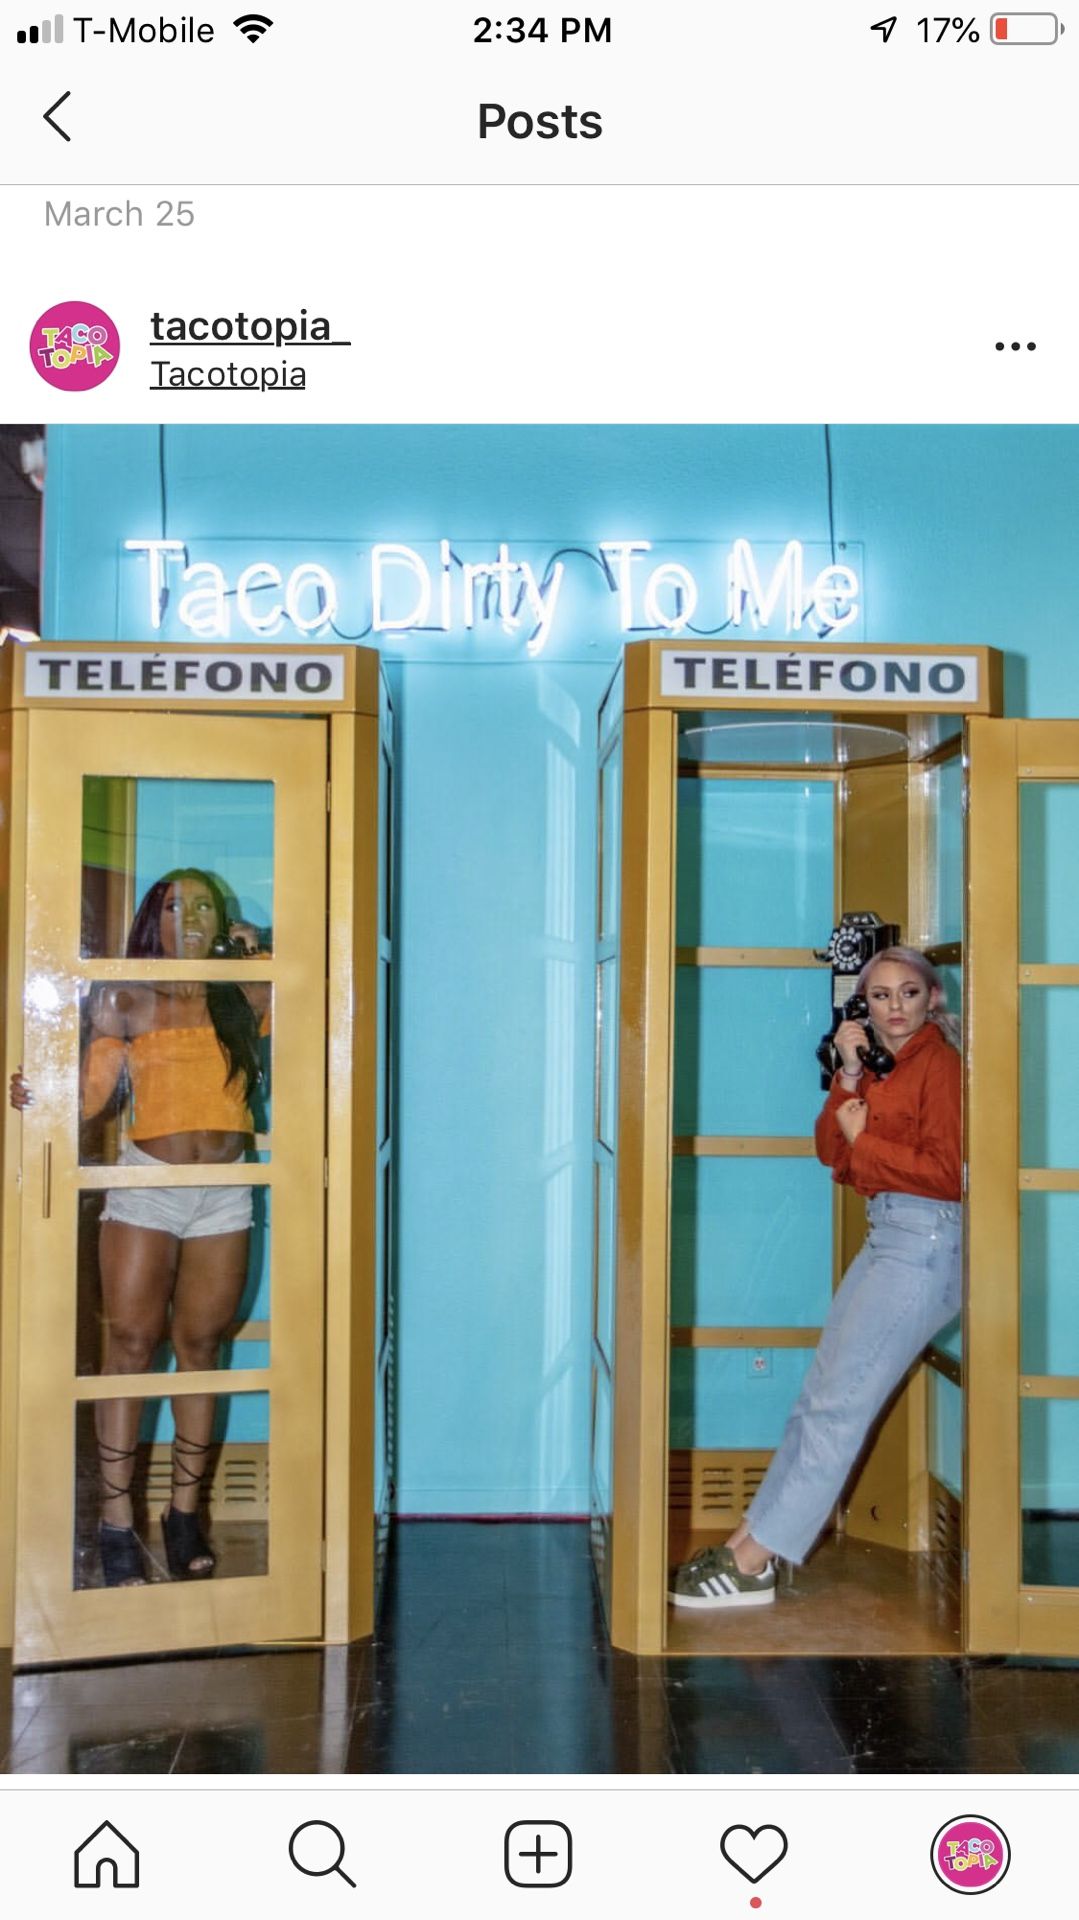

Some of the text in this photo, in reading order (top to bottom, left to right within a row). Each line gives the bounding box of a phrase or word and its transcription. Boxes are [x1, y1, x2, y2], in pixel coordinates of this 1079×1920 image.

[73, 16, 214, 43] T-Mobile
[474, 17, 611, 43] 2:34 PM
[918, 17, 979, 42] 17%
[480, 104, 602, 139] Posts
[46, 200, 194, 226] March 25
[41, 322, 108, 348] TACO
[150, 309, 351, 347] tacotopia_
[37, 343, 114, 370] TOPIA
[150, 360, 305, 392] Tacotopia
[123, 537, 859, 655] Taco Dirty To Me
[38, 653, 333, 694] TELÉFONO
[673, 653, 966, 694] TELÉFONO
[946, 1838, 995, 1856] TACO
[944, 1852, 999, 1872] TOPIA
